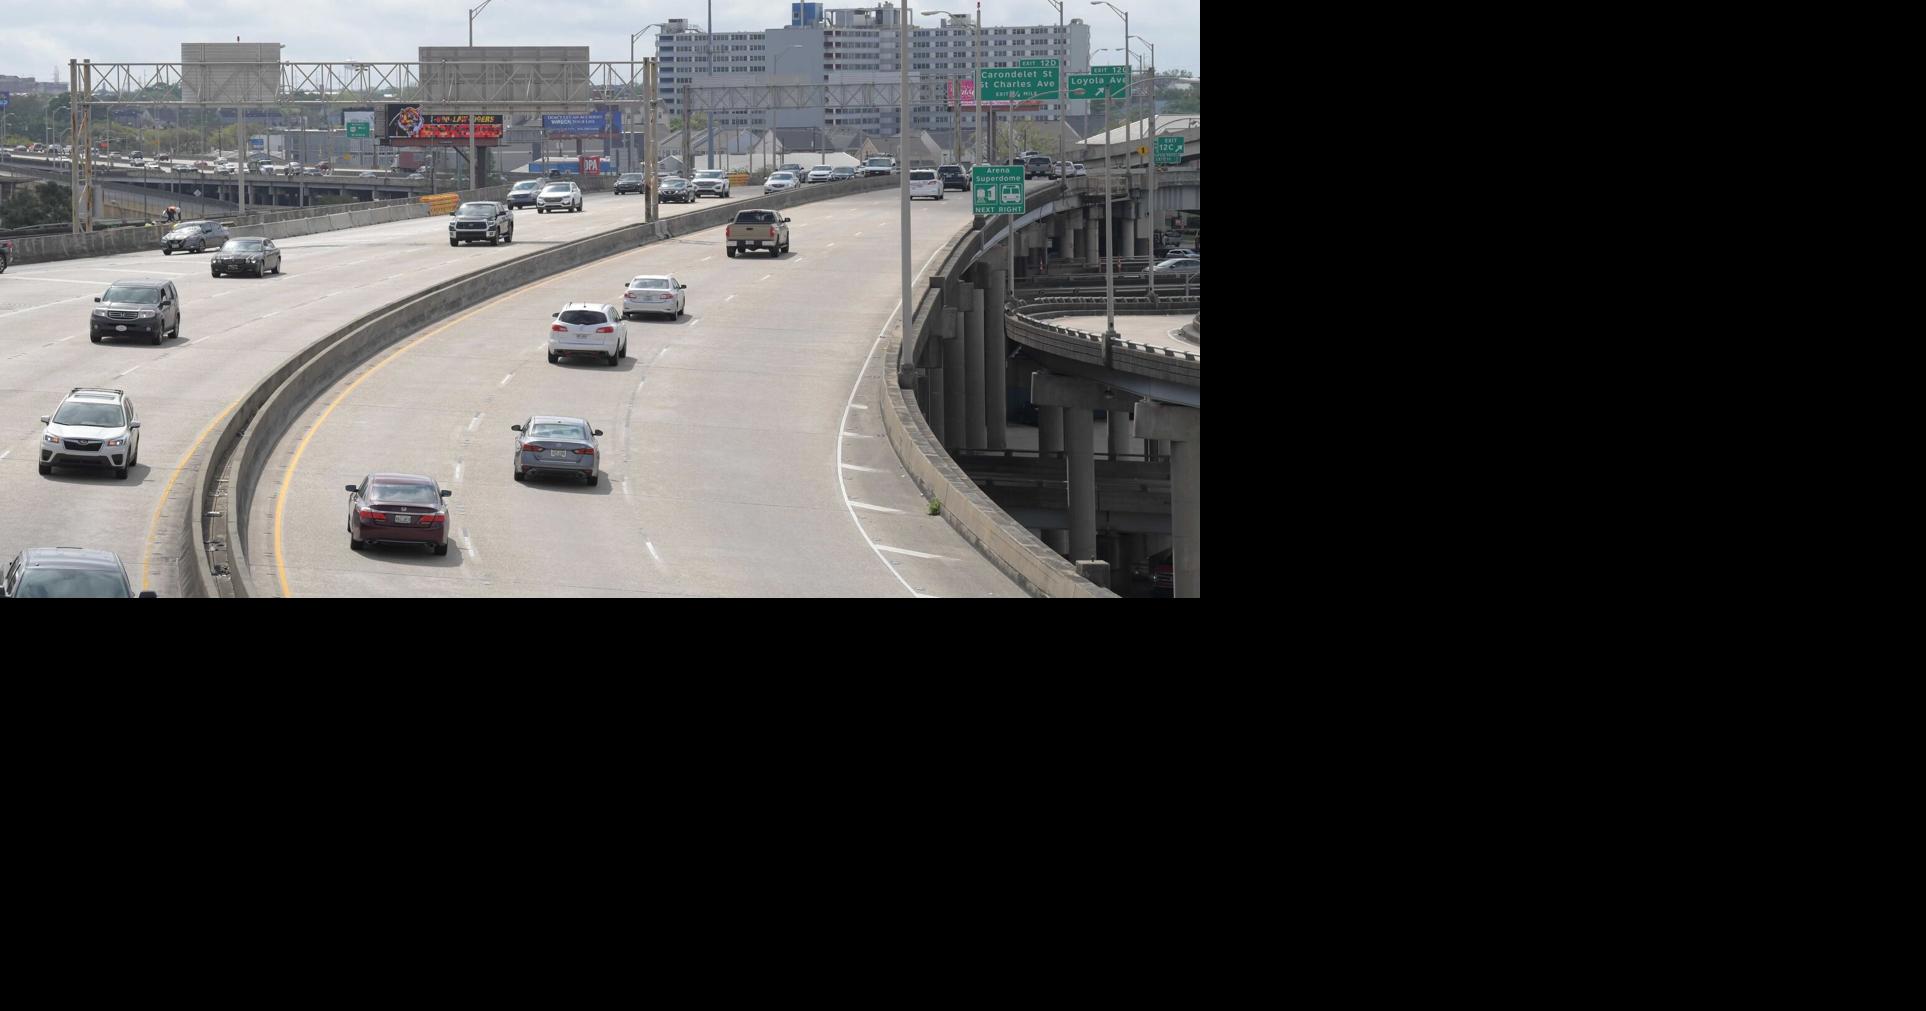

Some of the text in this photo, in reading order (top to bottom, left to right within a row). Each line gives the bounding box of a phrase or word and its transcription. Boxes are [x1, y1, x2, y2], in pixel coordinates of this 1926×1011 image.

[981, 70, 1053, 79] Carondelet St
[980, 80, 989, 88] St
[993, 80, 1032, 88] Charles
[1071, 76, 1105, 86] Loyola
[1159, 143, 1174, 151] 12C
[975, 175, 1022, 183] Superdome
